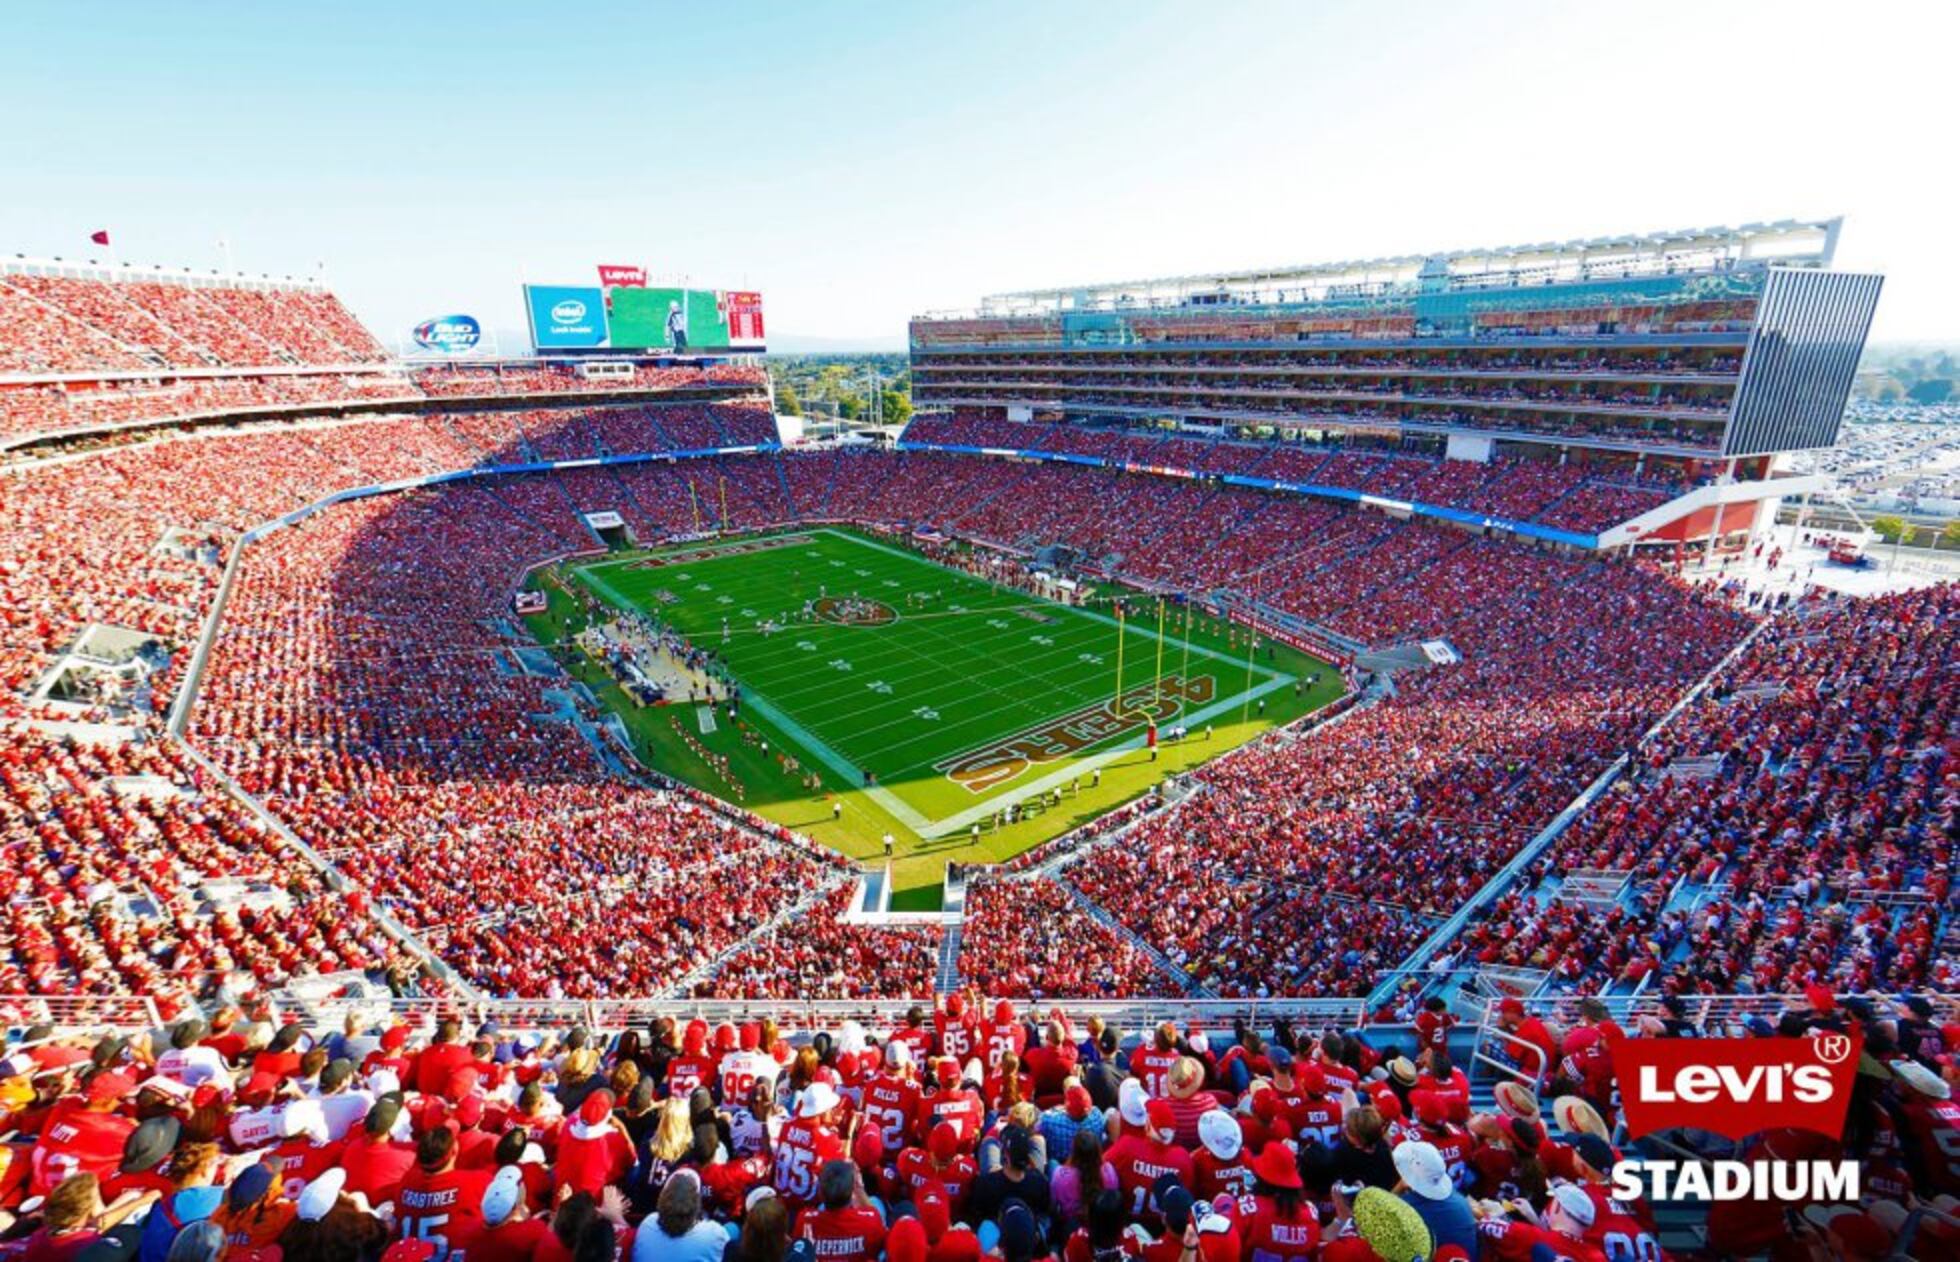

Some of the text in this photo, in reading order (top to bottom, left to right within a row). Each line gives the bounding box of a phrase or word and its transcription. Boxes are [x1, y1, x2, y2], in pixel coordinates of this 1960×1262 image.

[943, 1030, 969, 1056] 85
[402, 1188, 459, 1209] CRABTREE
[1271, 1223, 1308, 1245] WILLIS
[815, 1236, 864, 1255] AEPERNICK
